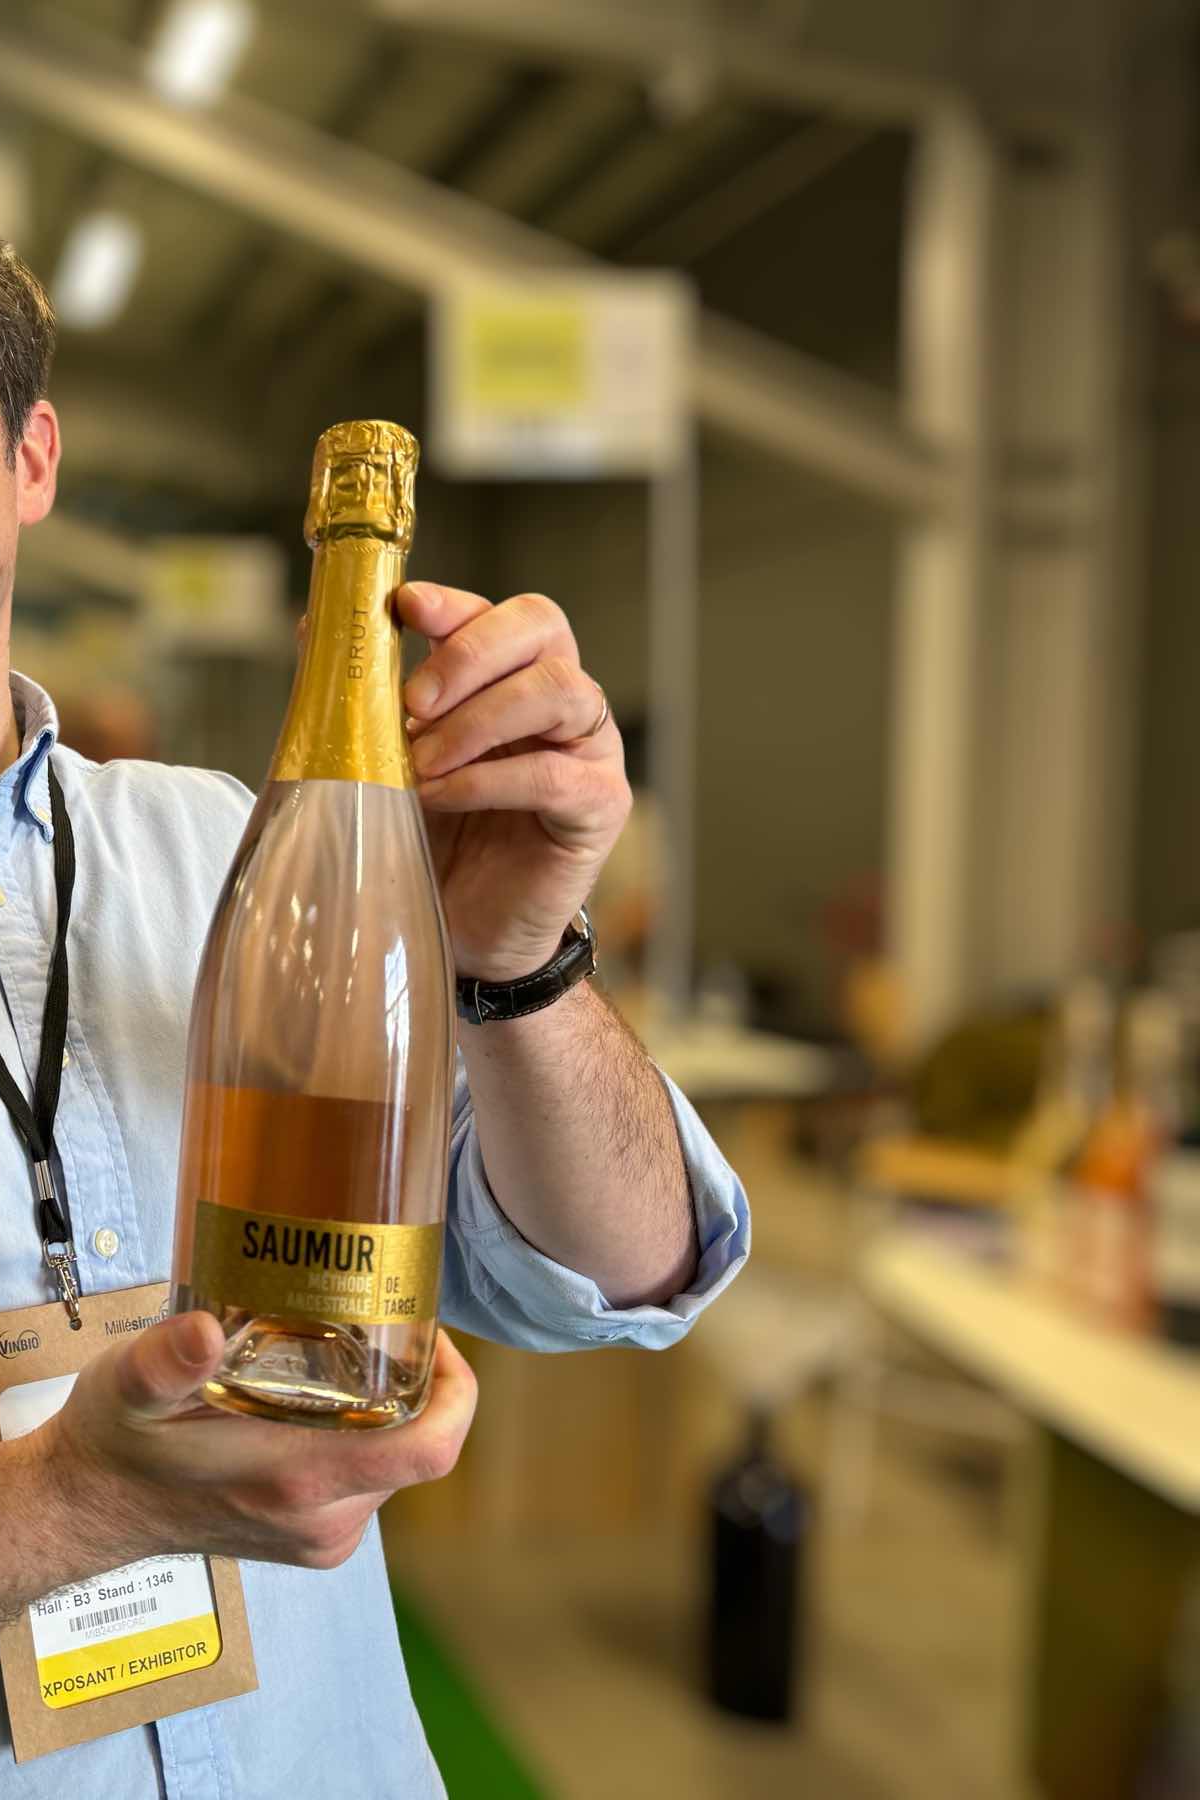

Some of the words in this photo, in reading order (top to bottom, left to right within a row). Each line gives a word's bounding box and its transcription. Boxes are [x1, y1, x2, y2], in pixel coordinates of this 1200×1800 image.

[348, 604, 368, 679] BRUT
[242, 1221, 375, 1273] SAUMUR
[385, 1276, 400, 1294] DE
[37, 1599, 63, 1617] Hall
[73, 1592, 91, 1608] B3
[98, 1581, 135, 1601] Stand
[145, 1571, 174, 1588] 1346
[41, 1665, 116, 1699] XPOSANT
[128, 1641, 208, 1676] EXHIBITOR
